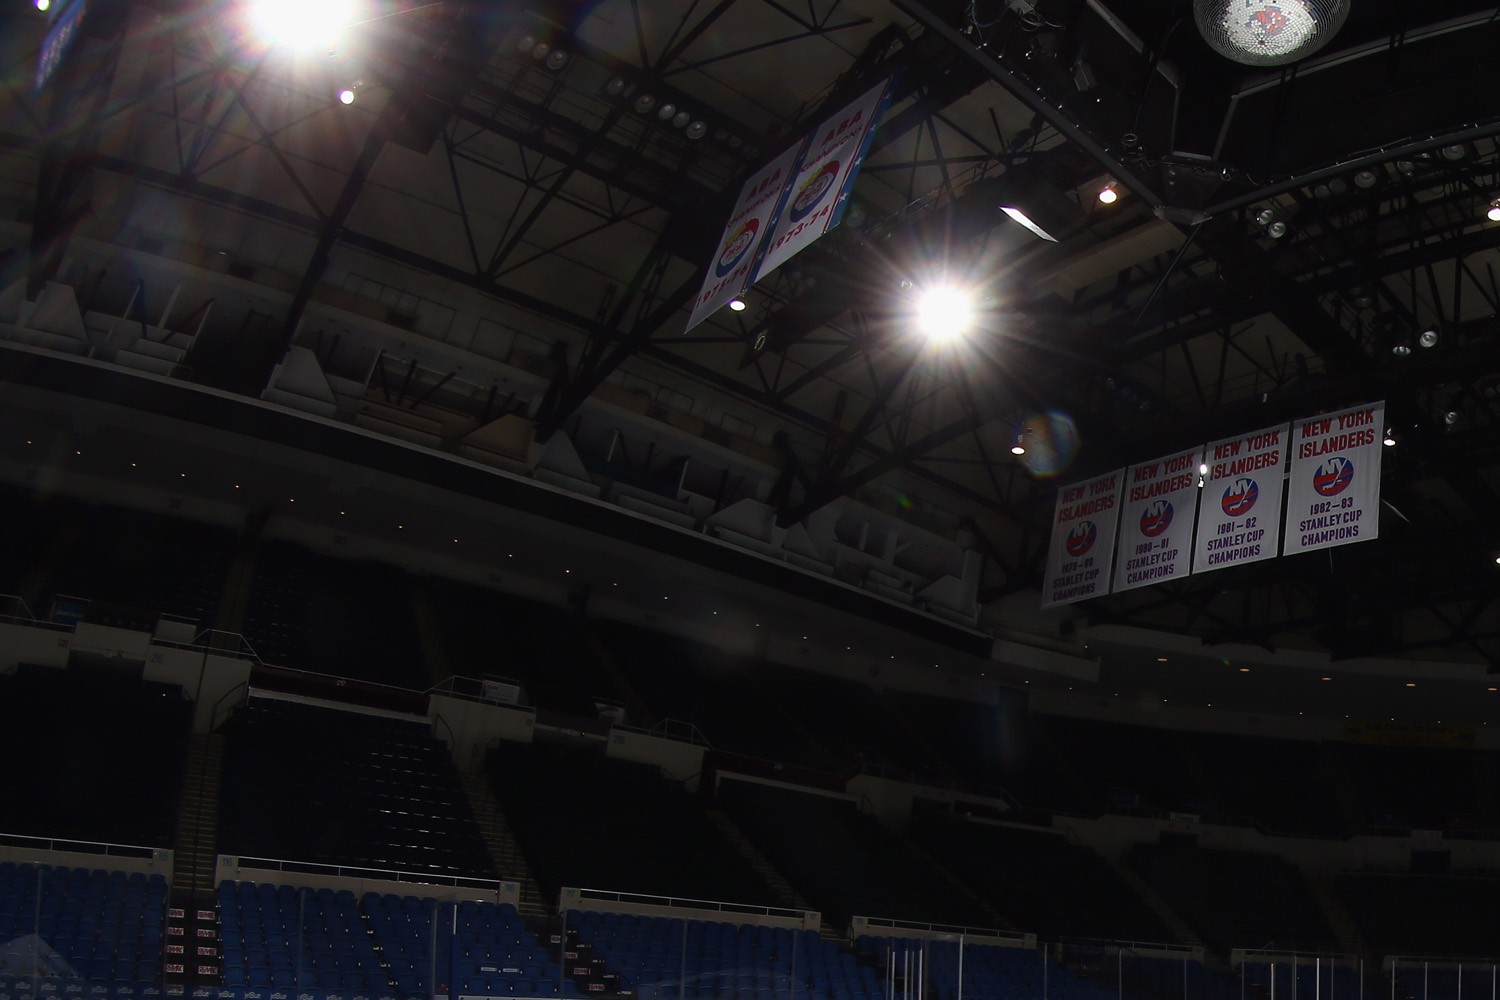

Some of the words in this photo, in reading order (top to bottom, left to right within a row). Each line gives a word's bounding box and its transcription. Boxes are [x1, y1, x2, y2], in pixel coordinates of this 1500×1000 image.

[822, 110, 863, 147] ABA
[801, 125, 864, 174] CHAMPIONS
[746, 168, 782, 202] ABA
[1302, 418, 1332, 439] NEW
[1338, 408, 1375, 431] YORK
[1213, 441, 1242, 461] NEW
[1247, 430, 1280, 452] YORK
[1299, 428, 1375, 459] ISLANDERS
[1134, 462, 1160, 483] NEW
[1164, 453, 1194, 472] YORK
[1209, 450, 1280, 481] ISLANDERS
[1062, 485, 1085, 504] NEW
[1089, 475, 1117, 496] YORK
[1130, 472, 1193, 502] ISLANDERS
[1059, 495, 1115, 523] ISLANDERS
[1300, 513, 1341, 532] STANLEY
[1342, 509, 1362, 524] CUP
[1207, 532, 1245, 551] STANLEY
[1246, 529, 1264, 542] CUP
[1301, 525, 1359, 547] CHAMPIONS
[1126, 552, 1161, 571] STANLEY
[1161, 549, 1178, 561] CUP
[1208, 544, 1260, 565] CHAMPIONS
[1127, 563, 1175, 584] CHAMPIONS
[1053, 583, 1096, 601] CHAMPIONS
